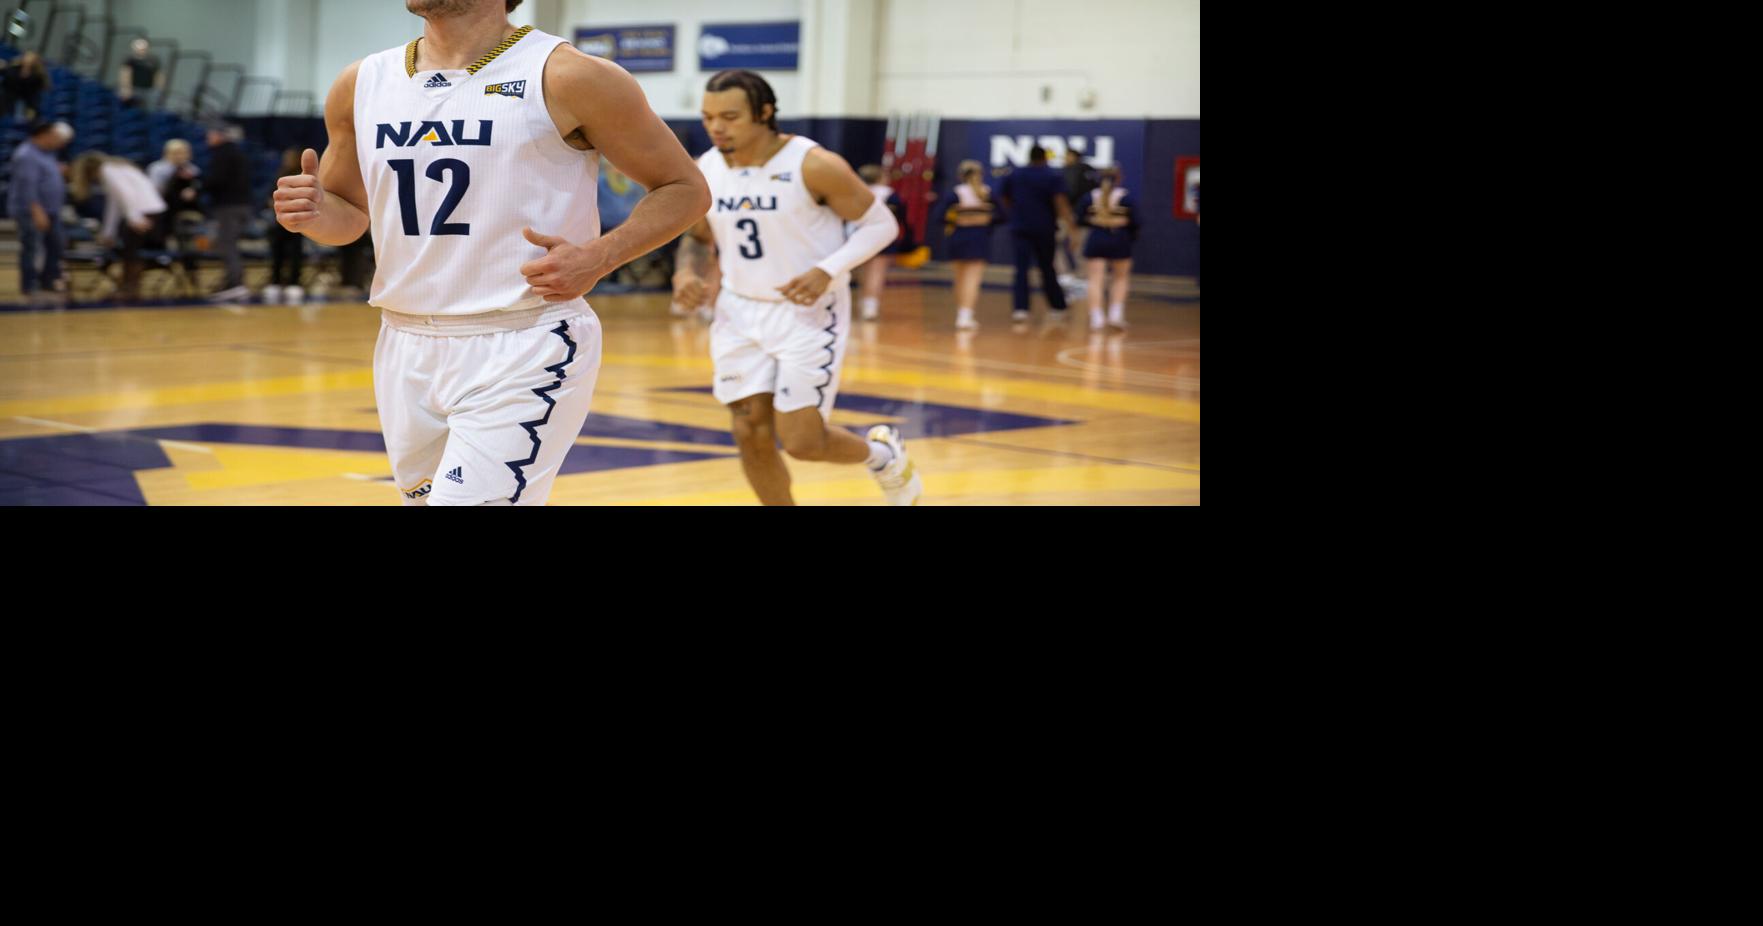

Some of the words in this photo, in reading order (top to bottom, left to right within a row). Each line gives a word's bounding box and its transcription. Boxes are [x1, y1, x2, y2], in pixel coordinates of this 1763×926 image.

[424, 81, 452, 89] adidas
[375, 119, 494, 149] NAU
[387, 157, 471, 236] 12
[717, 195, 777, 212] NAU
[736, 217, 763, 260] 3
